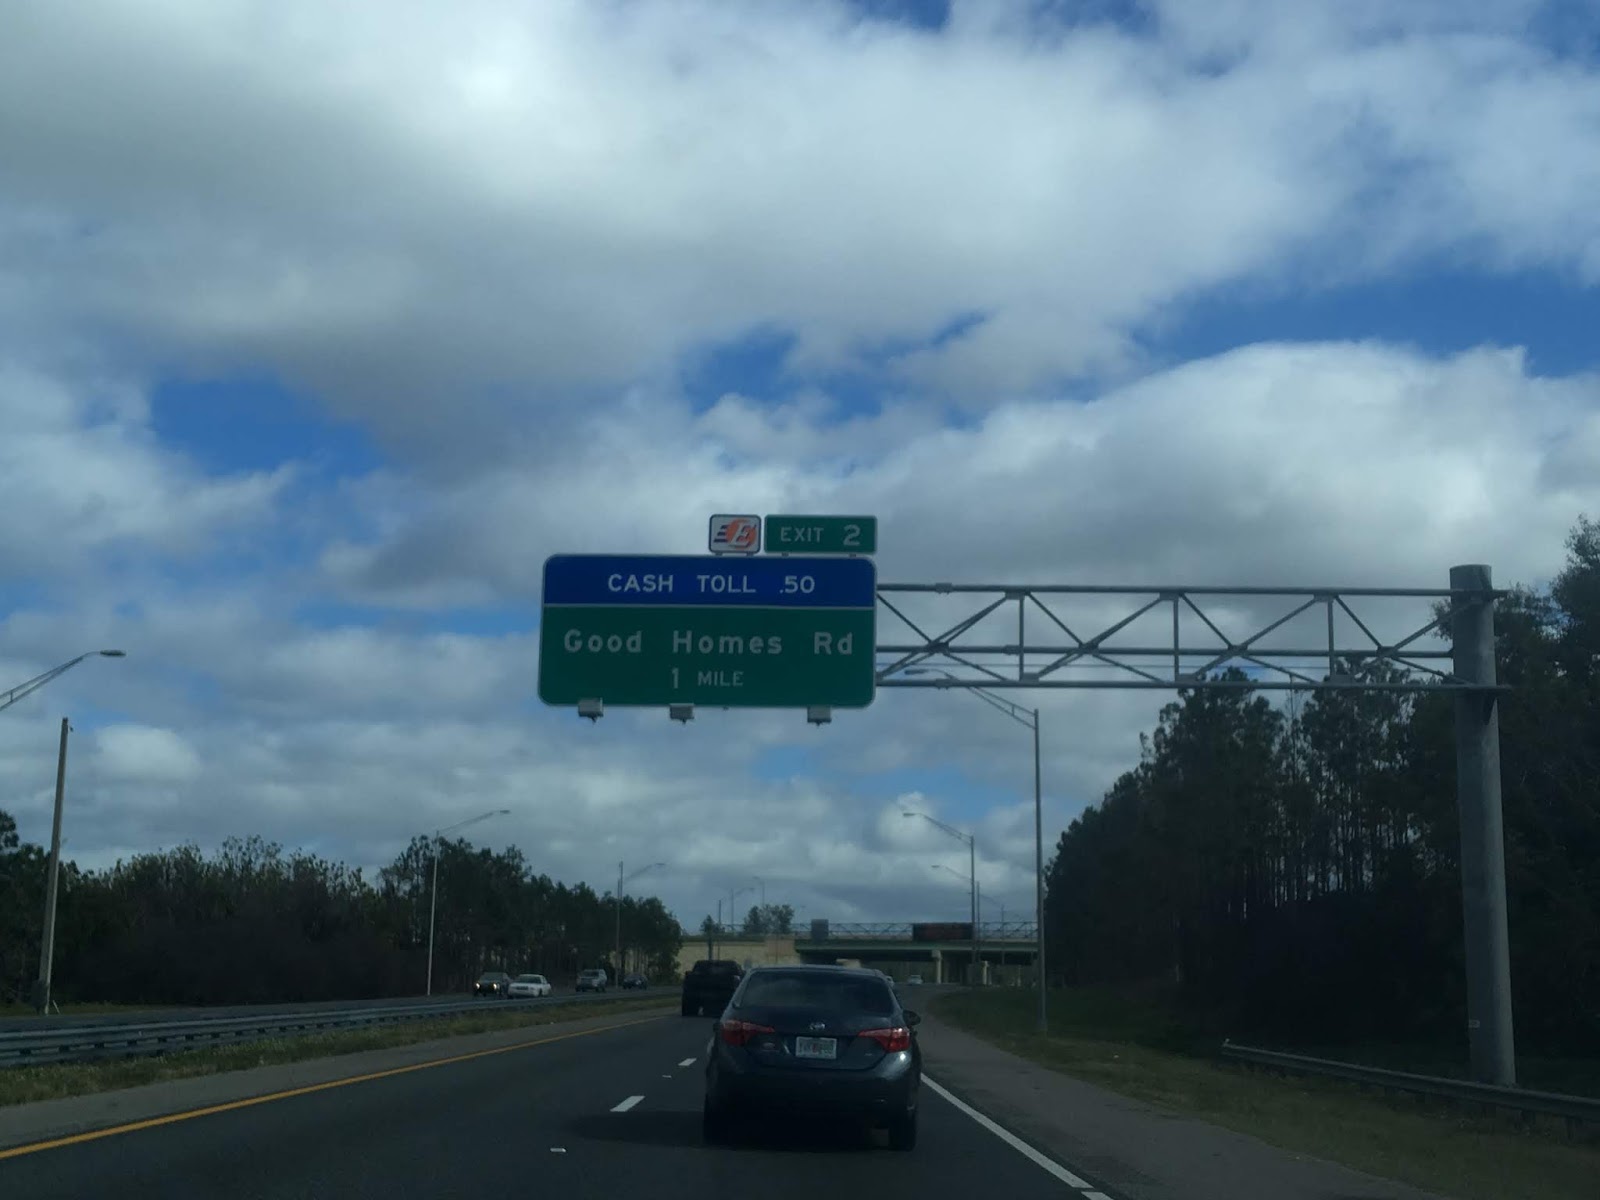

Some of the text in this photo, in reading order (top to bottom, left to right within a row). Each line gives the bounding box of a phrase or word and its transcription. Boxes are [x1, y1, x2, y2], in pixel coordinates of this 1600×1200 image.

[780, 524, 861, 546] EXIT 2
[607, 574, 816, 594] CASH TOLL .50
[563, 629, 853, 655] Good Homes Rd
[671, 667, 744, 689] 1 MILE
